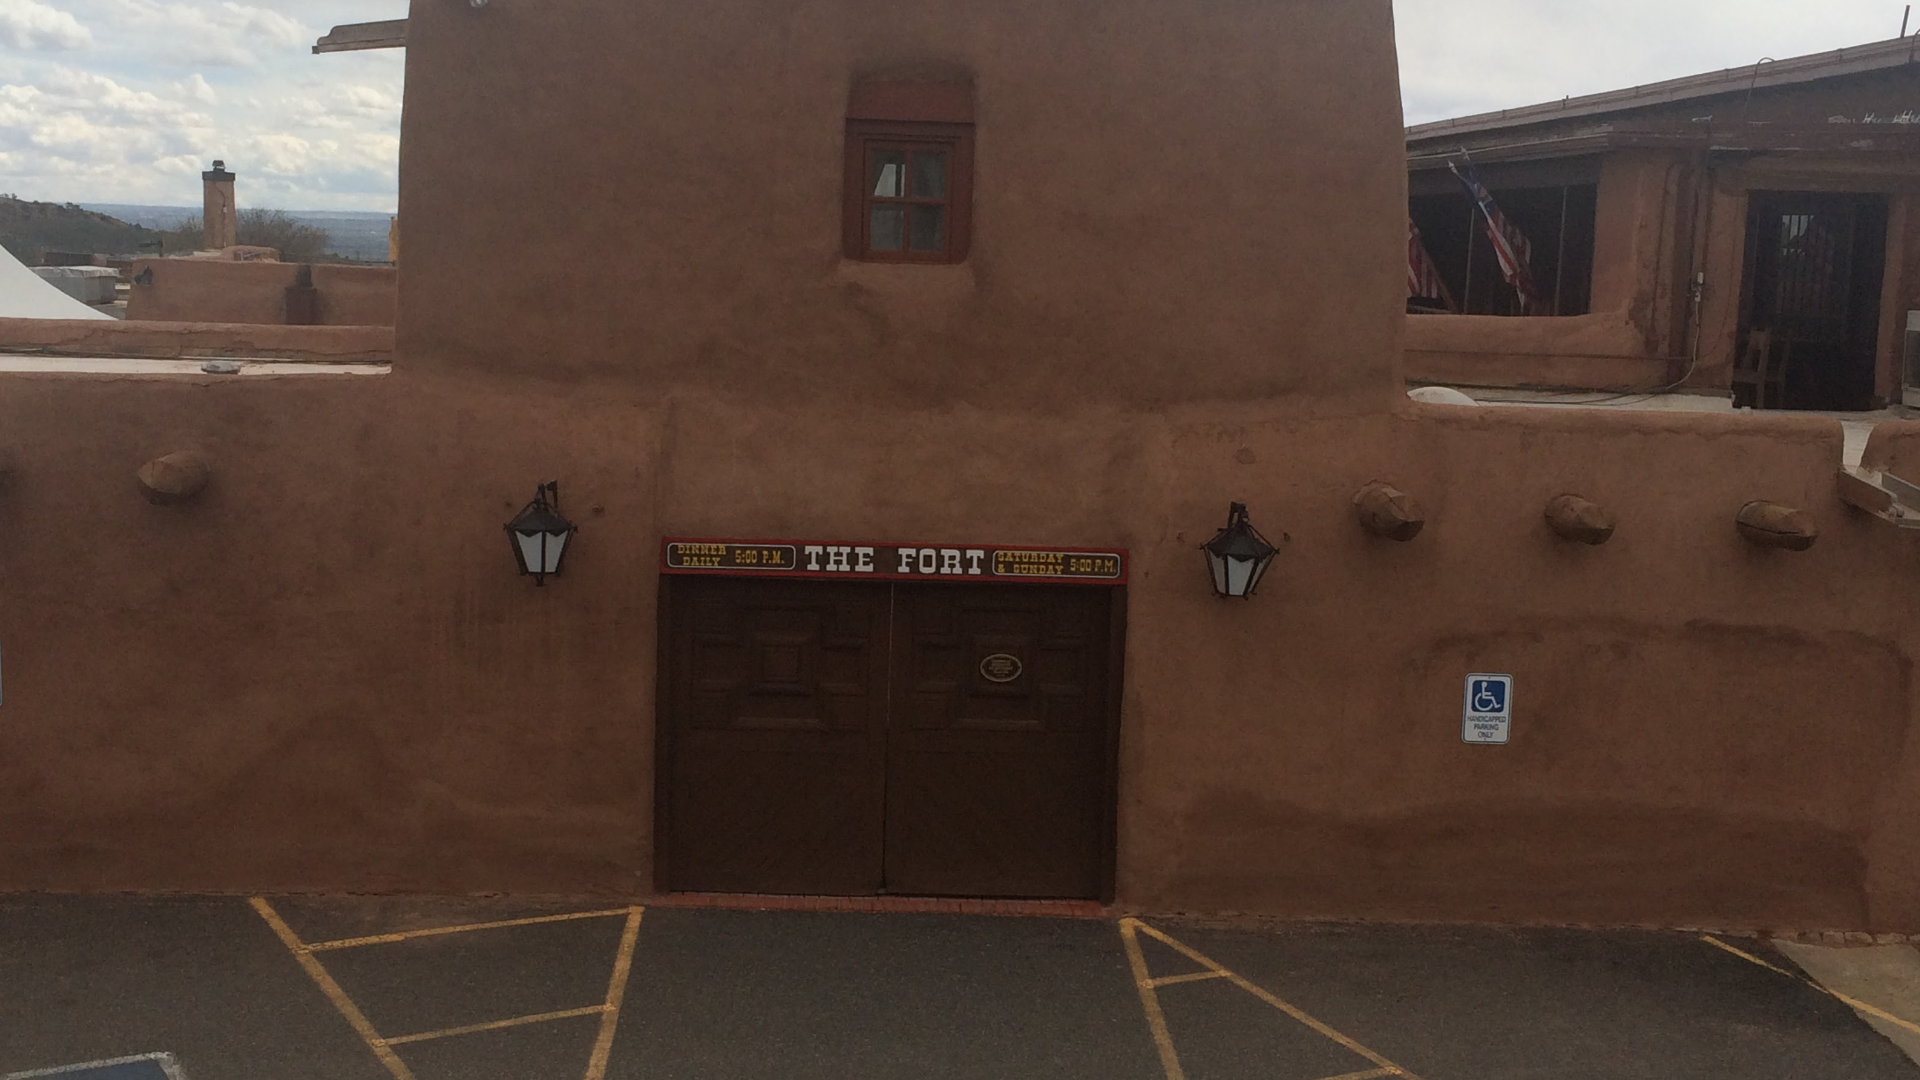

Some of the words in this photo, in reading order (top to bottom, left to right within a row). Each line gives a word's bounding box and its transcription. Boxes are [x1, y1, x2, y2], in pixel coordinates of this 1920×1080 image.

[677, 544, 726, 555] DINNER
[682, 556, 721, 567] DAILY
[735, 550, 757, 564] 5:00
[762, 550, 785, 564] P.M.
[804, 545, 874, 572] THE
[897, 548, 985, 574] FORT
[997, 552, 1064, 563] SATURDAY
[997, 564, 1005, 573] &
[1013, 564, 1064, 574] SUNDAY
[1070, 559, 1091, 572] 5:00
[1094, 559, 1116, 573] P.M.
[1467, 715, 1506, 723] HANDICAPPED
[1473, 723, 1499, 731] PARKING
[1477, 731, 1494, 739] ONLY
